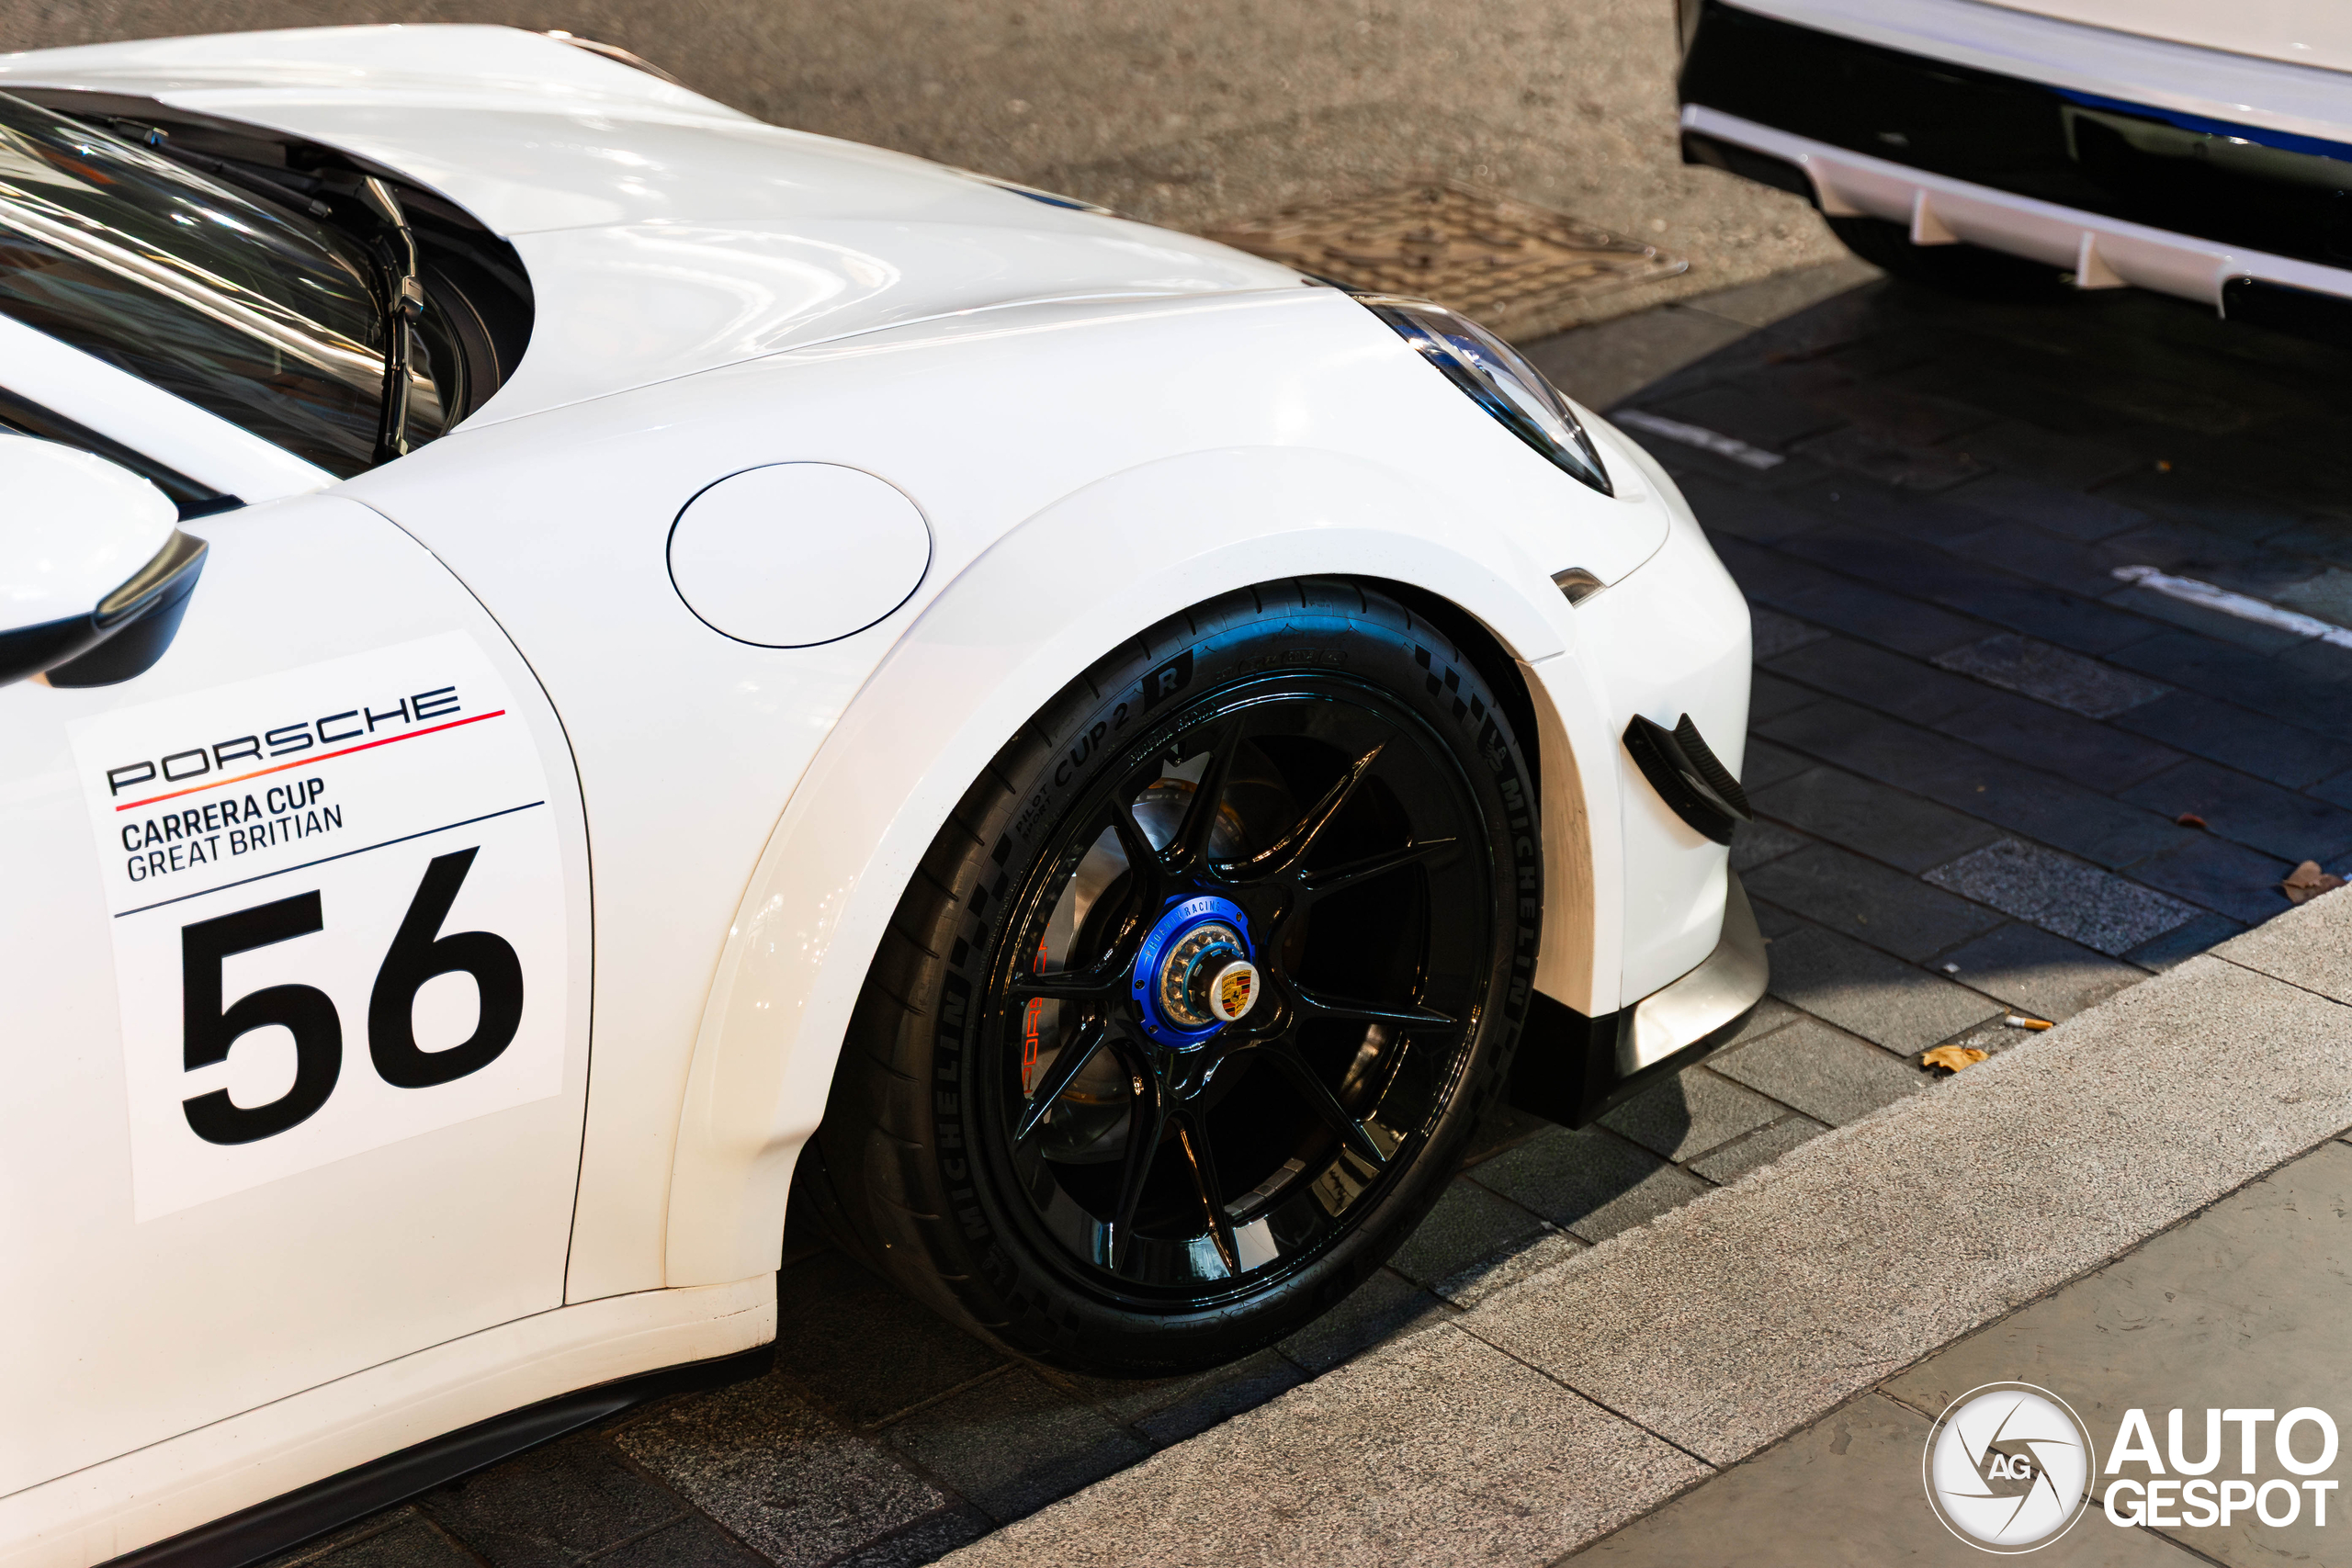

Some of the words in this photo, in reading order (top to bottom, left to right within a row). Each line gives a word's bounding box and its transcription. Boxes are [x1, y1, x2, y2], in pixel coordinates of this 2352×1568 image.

[107, 686, 461, 796] PORSCHE
[1054, 722, 1108, 788] CUP
[1113, 702, 1130, 731] 2
[121, 795, 263, 852] CARRERA
[266, 777, 324, 815] CUP
[128, 835, 220, 882] GREAT
[230, 804, 343, 855] BRITIAN
[1016, 784, 1046, 832] PILOT
[1146, 910, 1183, 957] PHOENIX
[1184, 900, 1221, 917] RACING
[1499, 777, 1537, 1007] MICHELIN
[182, 845, 524, 1145] 56
[937, 989, 989, 1241] MICHELIN
